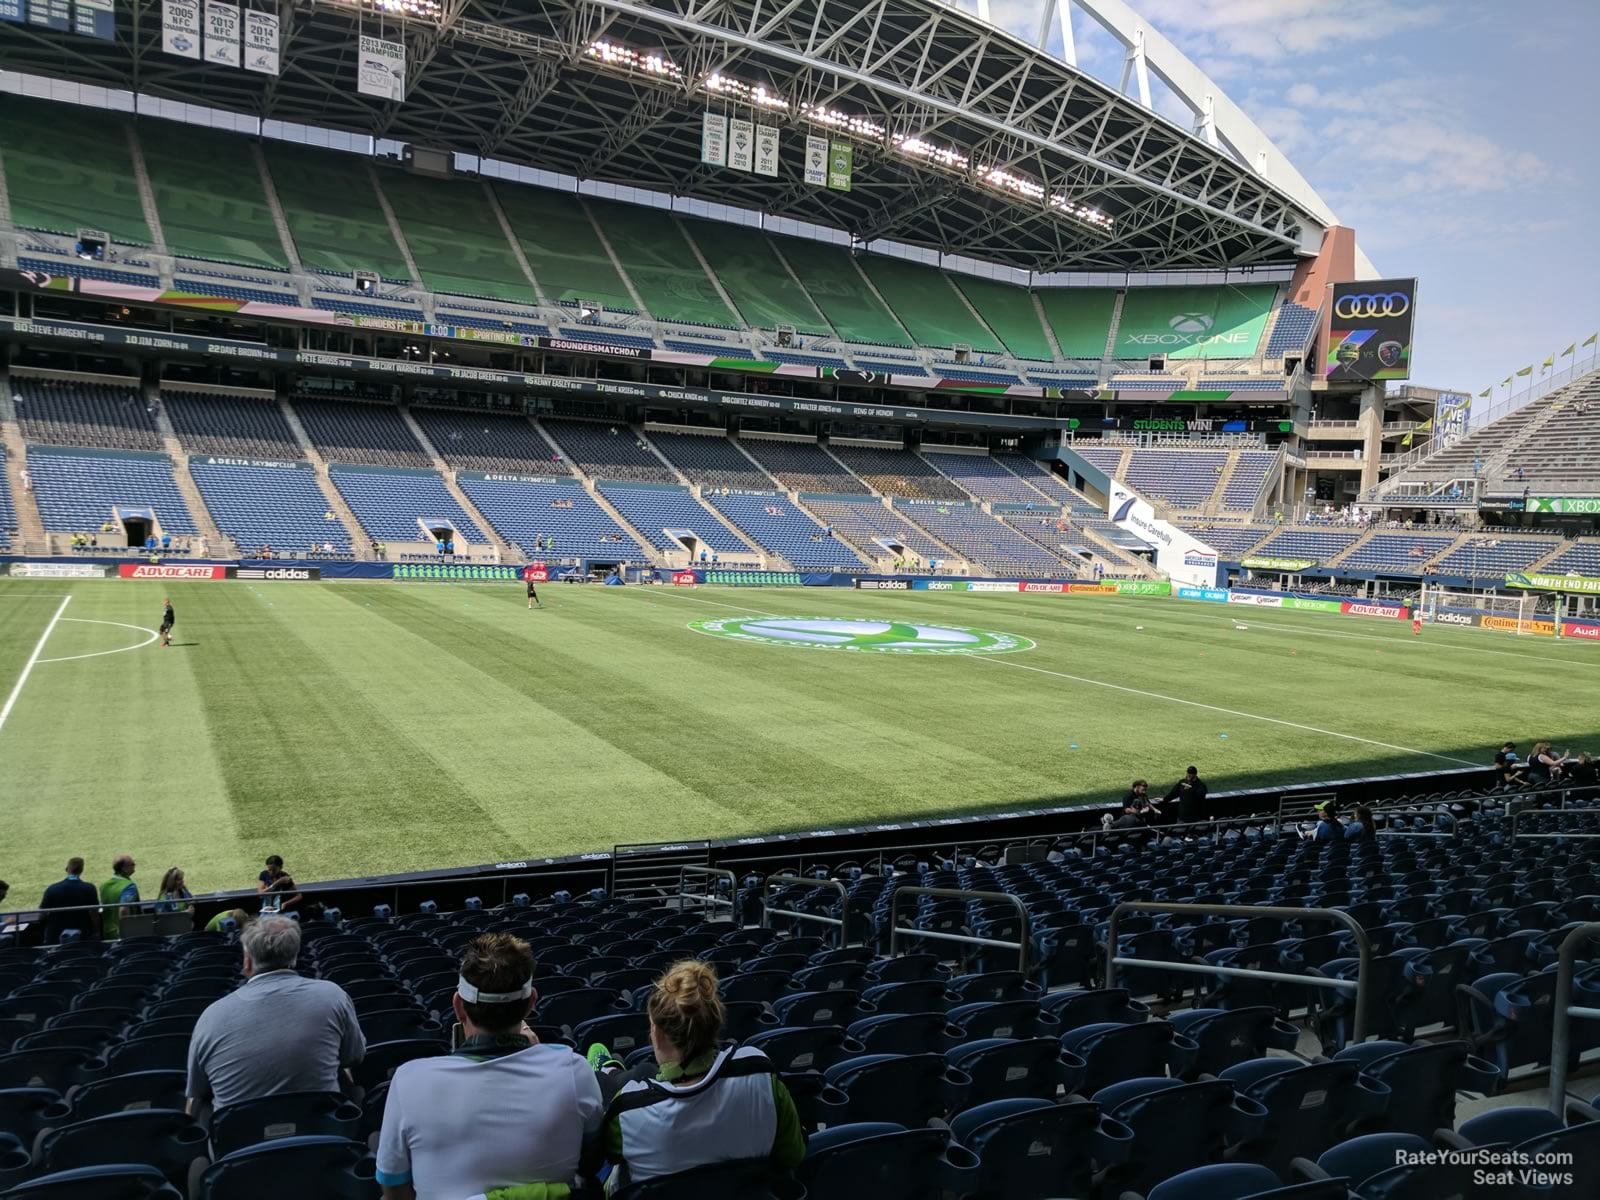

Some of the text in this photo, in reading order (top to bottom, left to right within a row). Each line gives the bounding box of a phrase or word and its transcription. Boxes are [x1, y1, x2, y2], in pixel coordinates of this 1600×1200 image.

[168, 5, 194, 19] 2005
[172, 16, 191, 27] NFC
[210, 16, 235, 29] 2013
[163, 22, 199, 36] CHAMPIONS
[213, 26, 231, 37] NFC
[250, 25, 274, 38] 2014
[205, 32, 239, 45] CHAMPIONS
[254, 35, 271, 46] NFC
[245, 41, 278, 54] CHAMPIONS
[361, 37, 404, 53] 2013 WORLD
[360, 45, 404, 60] CHAMPIONS
[732, 123, 752, 133] CHAMPS
[758, 130, 777, 139] CHAMPS
[808, 142, 827, 151] SHIELD
[734, 159, 747, 167] 2010
[760, 164, 773, 172] 2014
[805, 168, 826, 178] CHAMPS
[357, 270, 376, 278] 334
[13, 322, 28, 333] 80
[28, 324, 52, 335] STEVE
[53, 327, 87, 339] LARGENT
[359, 317, 419, 333] SOUNDERS FC 0
[430, 325, 449, 337] 0:00
[460, 328, 515, 343] 0 SPORTING KC
[125, 335, 138, 344] 10
[138, 336, 153, 346] JIM
[153, 338, 173, 349] ZORN
[1124, 332, 1249, 344] XBOX ONE
[208, 344, 221, 353] 22
[220, 345, 238, 356] DAVE
[238, 346, 263, 358] BROWN
[550, 339, 641, 357] #SOUNDERSMATCHDAY
[301, 353, 317, 364] PETE
[317, 355, 338, 366] GROSS
[369, 361, 380, 370] 28
[380, 362, 396, 372] CURT
[396, 363, 421, 374] WARNER
[450, 368, 460, 377] 79
[460, 369, 478, 379] JACOB
[478, 371, 496, 381] GREEN
[524, 376, 534, 385] 45
[534, 377, 551, 387] KENNY
[552, 379, 571, 389] EASLEY
[605, 384, 617, 393] DAVE
[617, 385, 634, 394] KRIEG
[667, 391, 684, 399] CHUCK
[684, 392, 698, 400] KNOX
[731, 397, 748, 406] CORTEZ
[748, 398, 770, 407] KENNEDY
[793, 402, 801, 410] 71
[800, 403, 817, 411] WALTER
[818, 404, 832, 412] JONES
[853, 407, 867, 415] RING
[876, 409, 894, 417] HONOR
[1133, 419, 1213, 431] STUDENTS WIN!
[218, 458, 249, 466] DELTA
[492, 474, 517, 482] DELTA
[1130, 514, 1173, 546] Insure Carefully
[135, 567, 212, 578] ADVOCARE
[266, 569, 309, 579] adidas
[879, 580, 907, 589] adidas
[928, 581, 953, 590] slalom
[1026, 584, 1062, 592] ADVOCARE
[1070, 584, 1099, 593] Continental
[1531, 577, 1562, 588] NORTH
[1563, 580, 1581, 589] END
[1350, 605, 1399, 617] ADVOCARE
[1437, 612, 1472, 624] adidas
[1484, 616, 1532, 630] Continental
[1573, 627, 1598, 636] Audi
[581, 853, 611, 861] slalom
[495, 861, 527, 869] slalom
